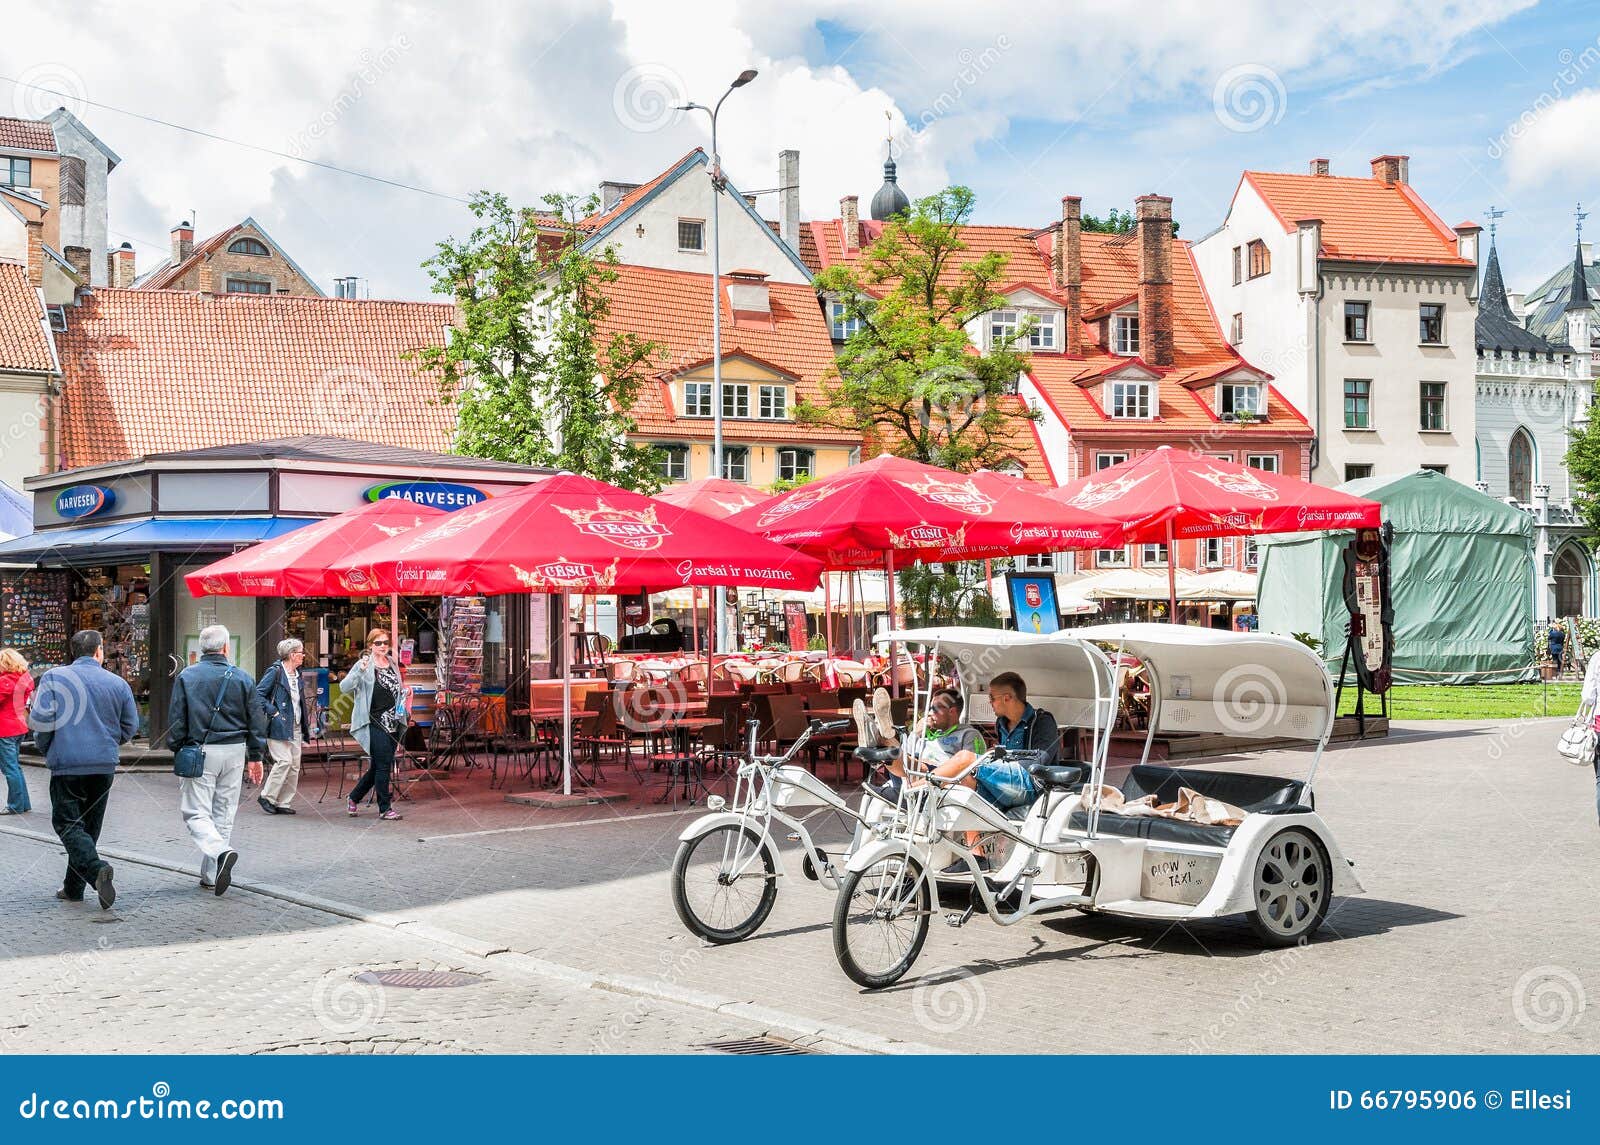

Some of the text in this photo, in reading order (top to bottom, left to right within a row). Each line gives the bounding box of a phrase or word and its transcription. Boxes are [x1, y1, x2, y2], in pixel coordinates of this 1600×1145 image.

[59, 493, 96, 510] NARVESEN
[389, 489, 477, 505] NARVESEN
[1049, 526, 1059, 538] ir
[676, 560, 728, 583] Garšai
[729, 564, 741, 577] ir
[1168, 872, 1191, 887] TAXI
